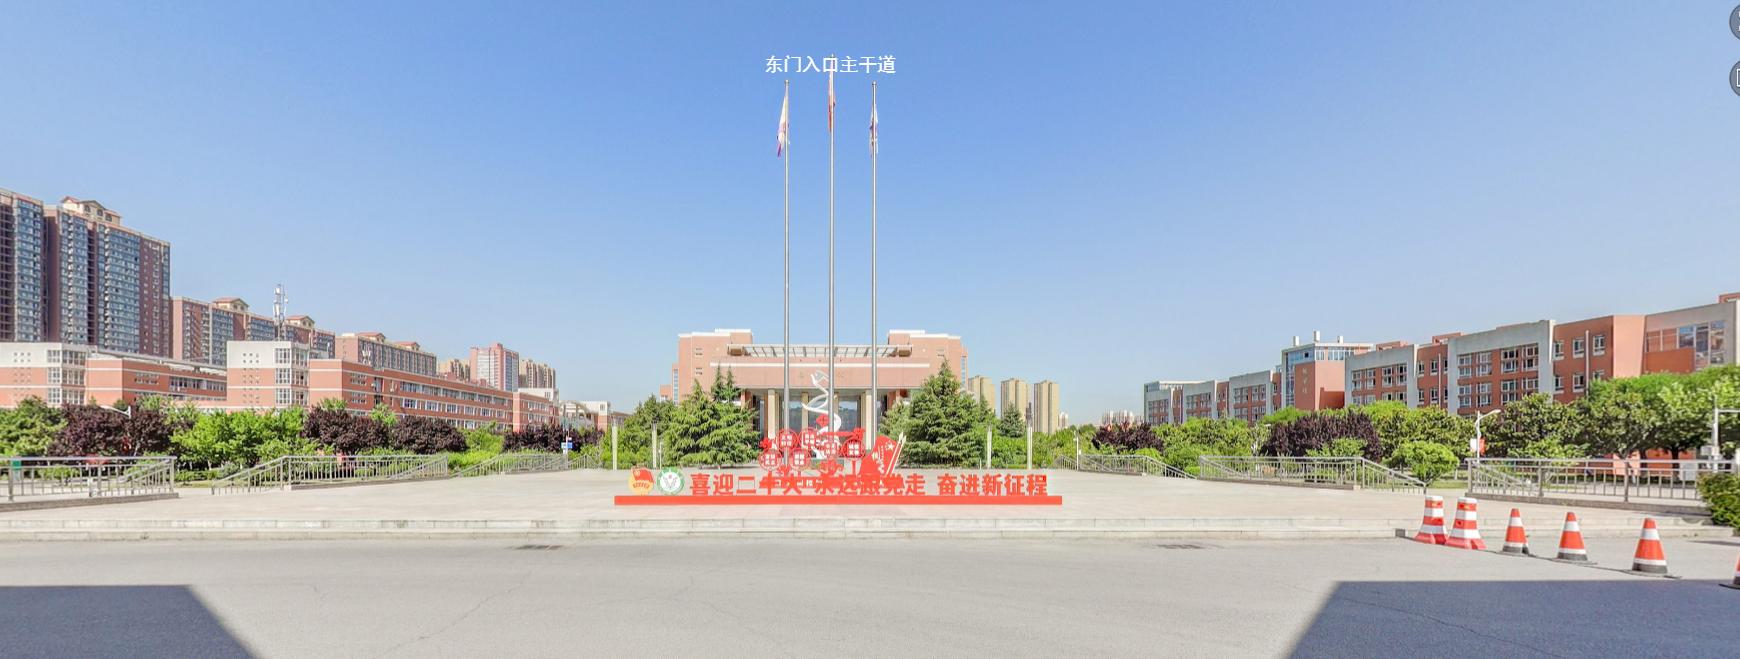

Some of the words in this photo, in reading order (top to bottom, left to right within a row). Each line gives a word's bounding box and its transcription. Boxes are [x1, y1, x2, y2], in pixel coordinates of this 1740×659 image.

[937, 473, 1047, 495] 奋进新征程
